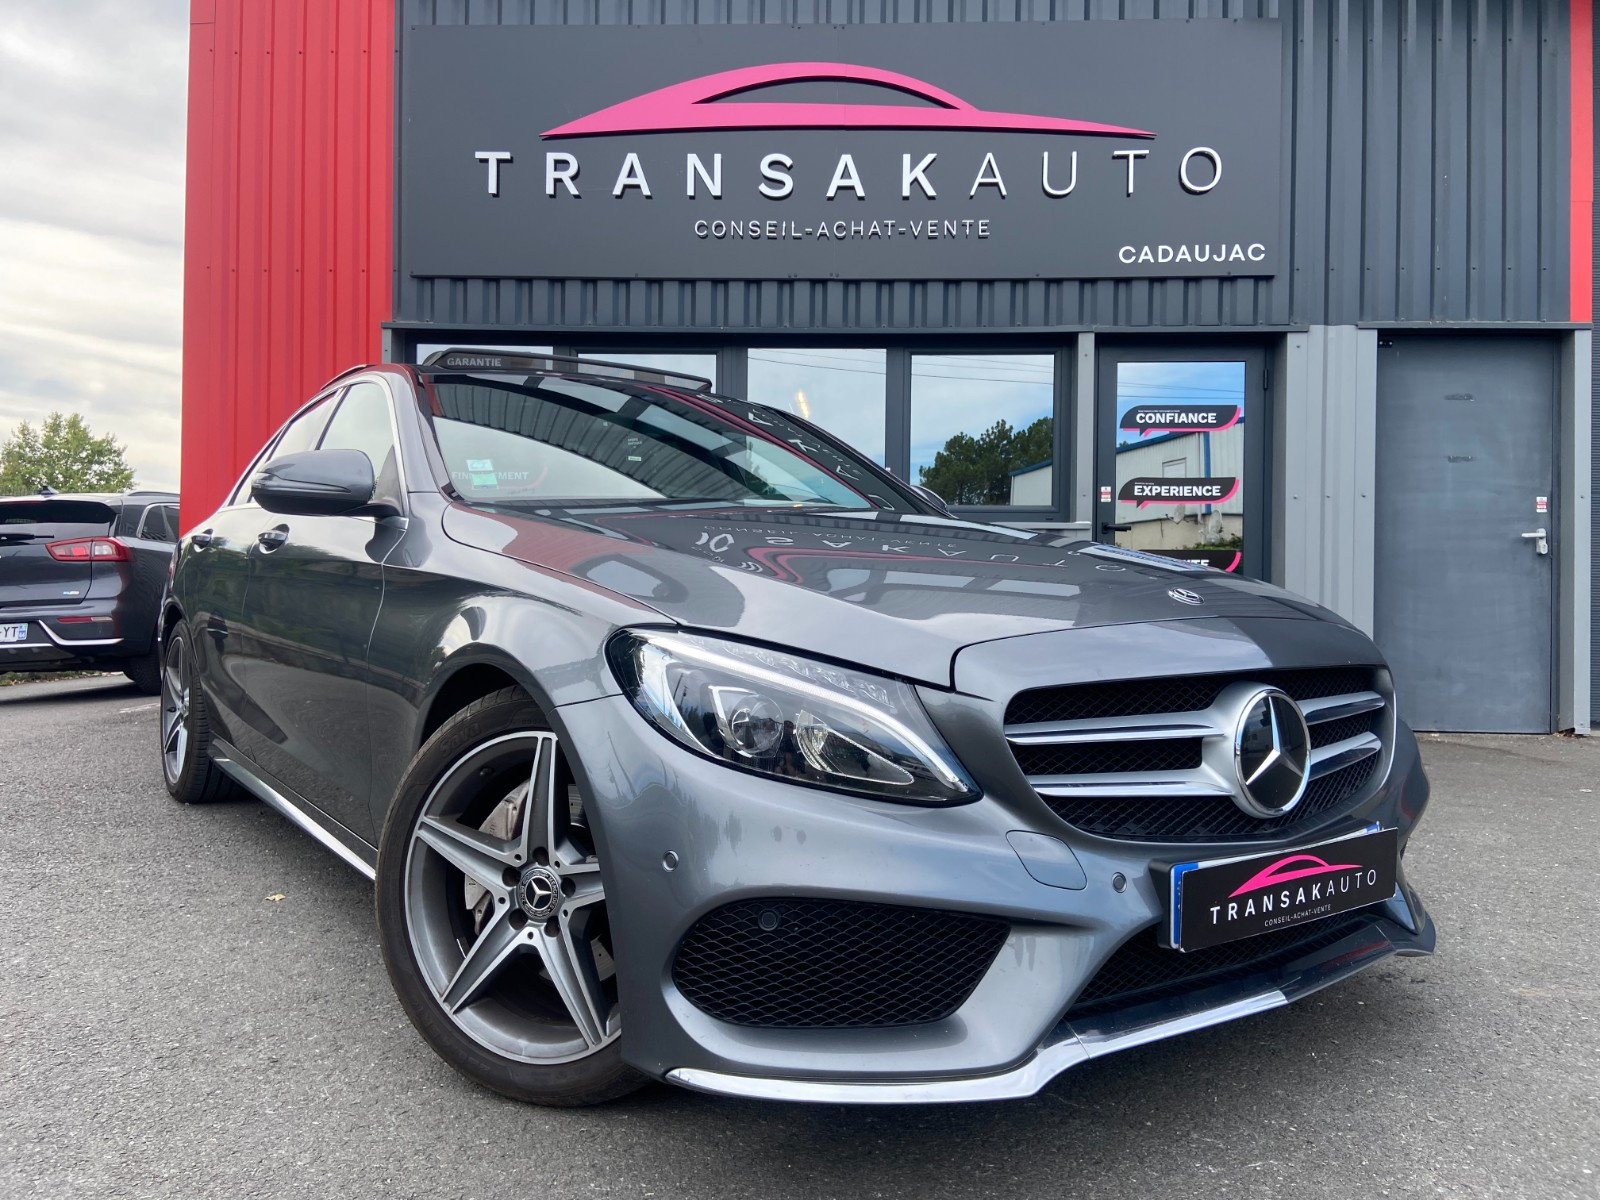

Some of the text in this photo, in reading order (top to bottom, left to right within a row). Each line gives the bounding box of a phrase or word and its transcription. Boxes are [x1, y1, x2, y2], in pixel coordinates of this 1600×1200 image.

[474, 146, 1222, 198] TRANSAKAUTO
[694, 219, 990, 237] CONSEIL-ACHAT-VENTE
[1118, 243, 1266, 264] CADAUJAC
[446, 357, 502, 367] GARANTIE
[1135, 412, 1217, 424] CONFIANCE
[1134, 485, 1221, 497] EXPERIENCE
[1209, 869, 1377, 925] TRANSAKAUTO
[1264, 904, 1332, 927] CONSEIL-ACHAT-VENTE
